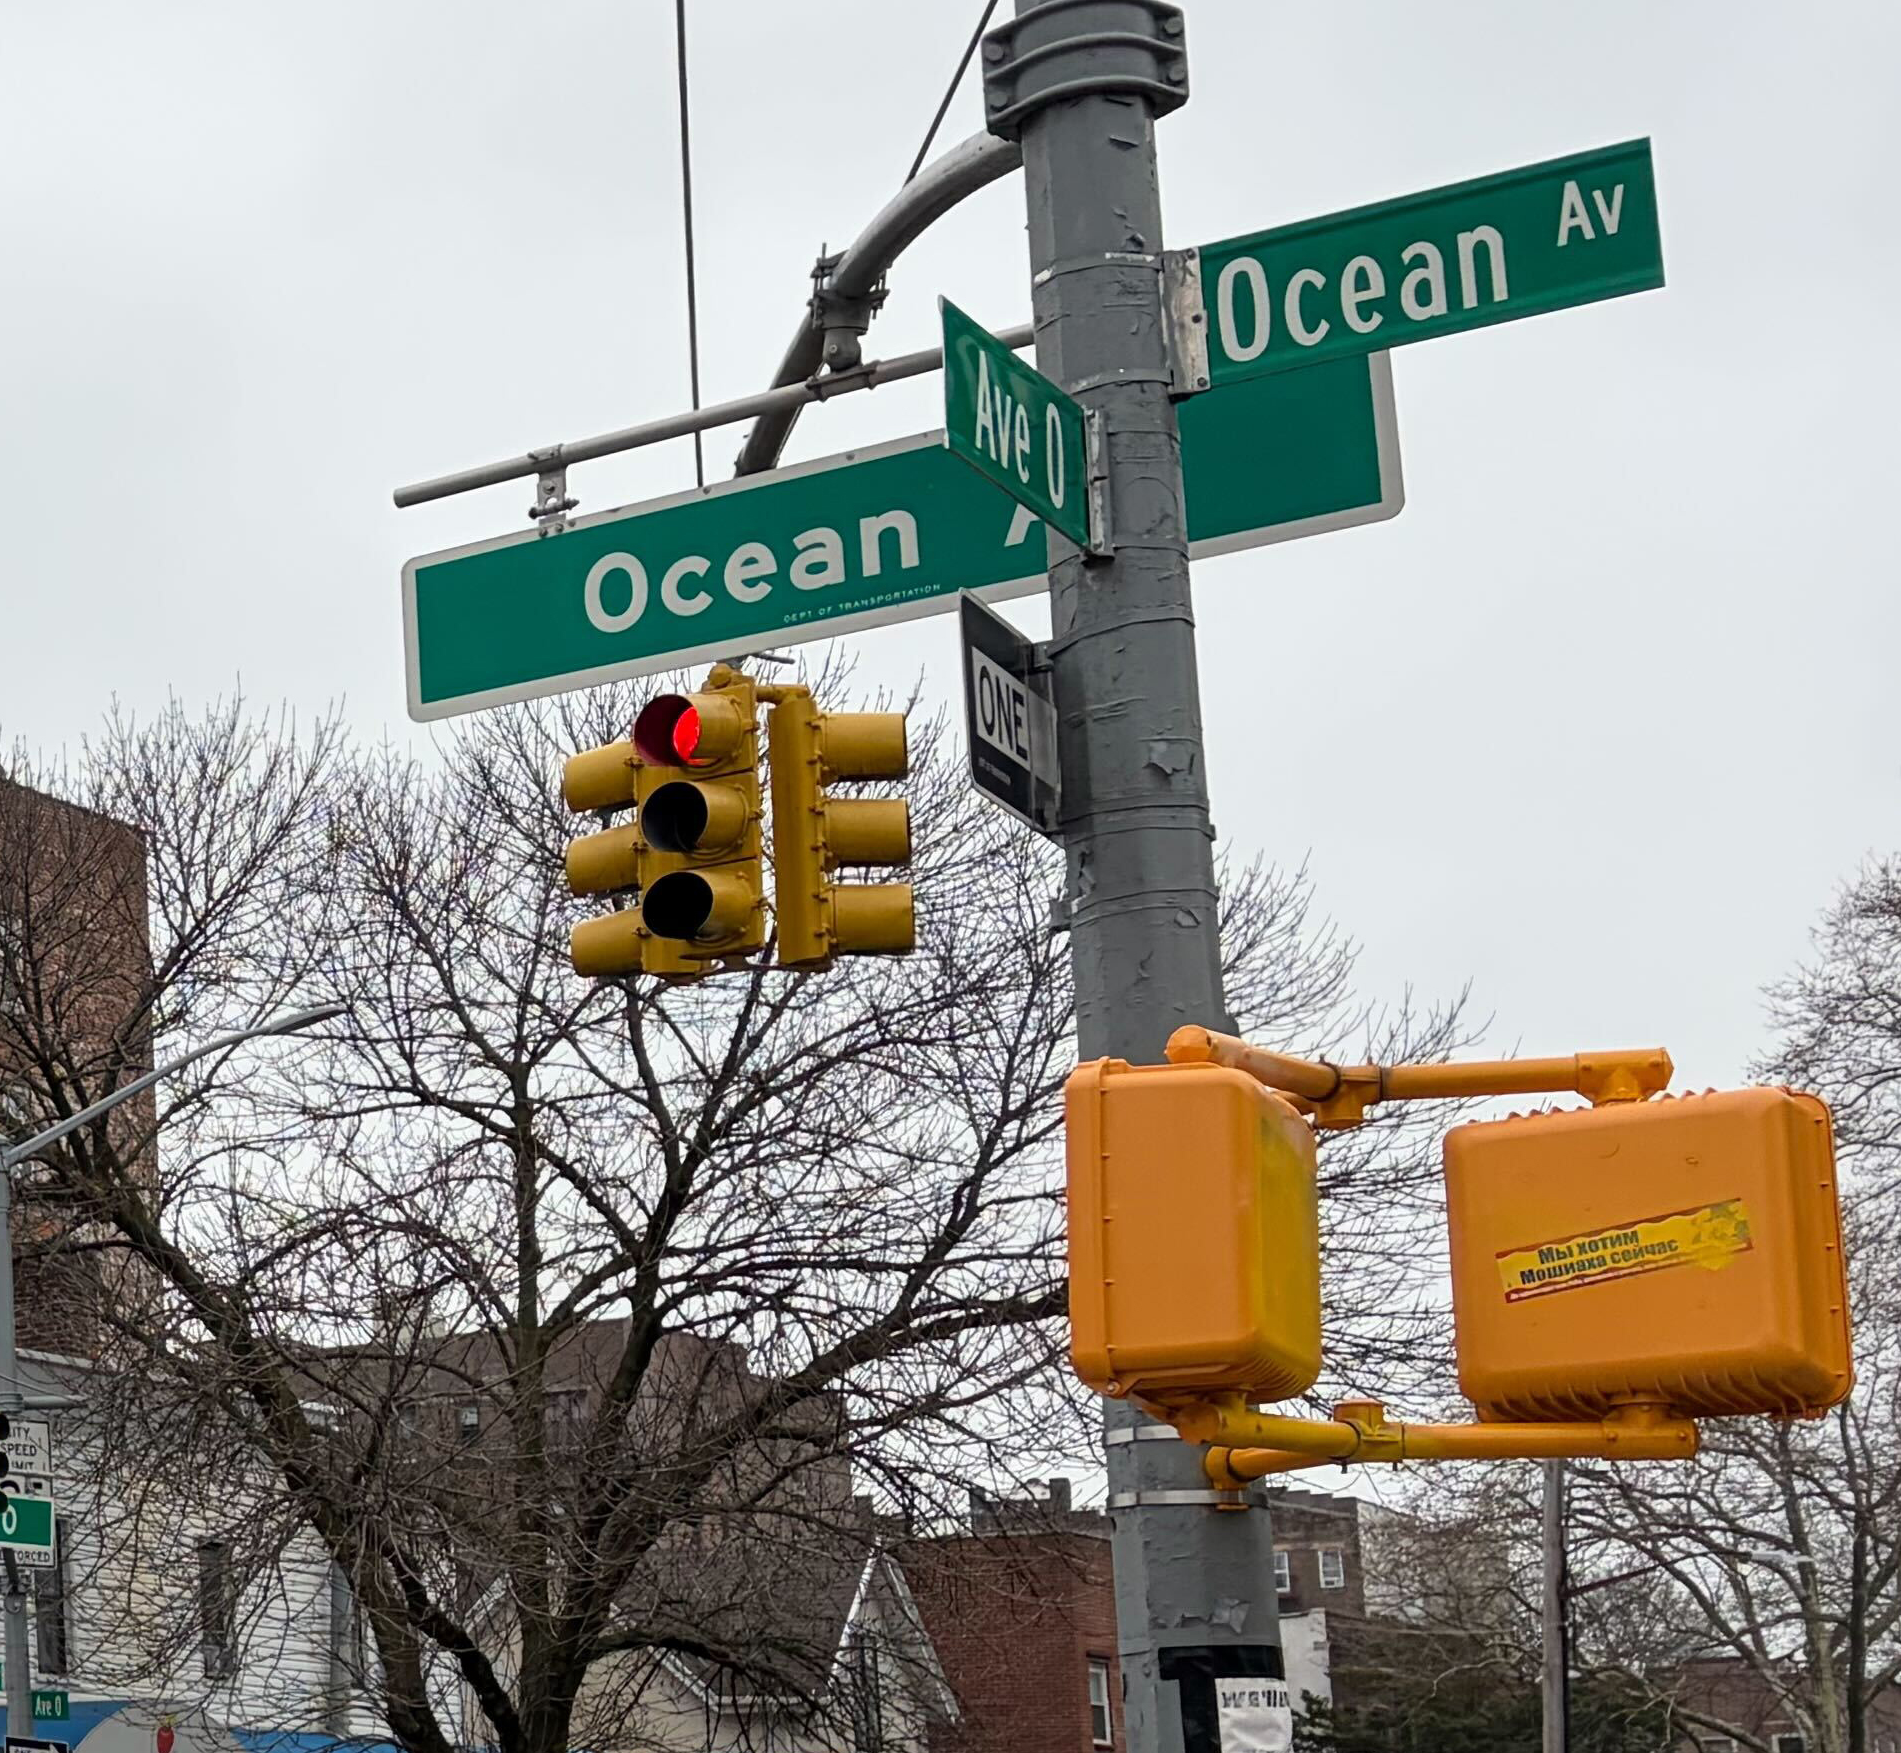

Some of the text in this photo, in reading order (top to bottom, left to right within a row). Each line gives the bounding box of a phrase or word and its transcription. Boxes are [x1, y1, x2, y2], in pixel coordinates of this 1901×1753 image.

[1217, 178, 1626, 364] Ocean Av
[975, 349, 1065, 509] Ave O
[583, 508, 921, 634] Ocean
[783, 583, 941, 624] DEPT OF TRANSPORTATION
[978, 664, 1030, 764] ONE
[1519, 1238, 1679, 1285] Мошиаха сейчас
[1537, 1230, 1640, 1265] Мы хотим
[0, 1442, 37, 1457] SPEED
[35, 1695, 52, 1716] Ave
